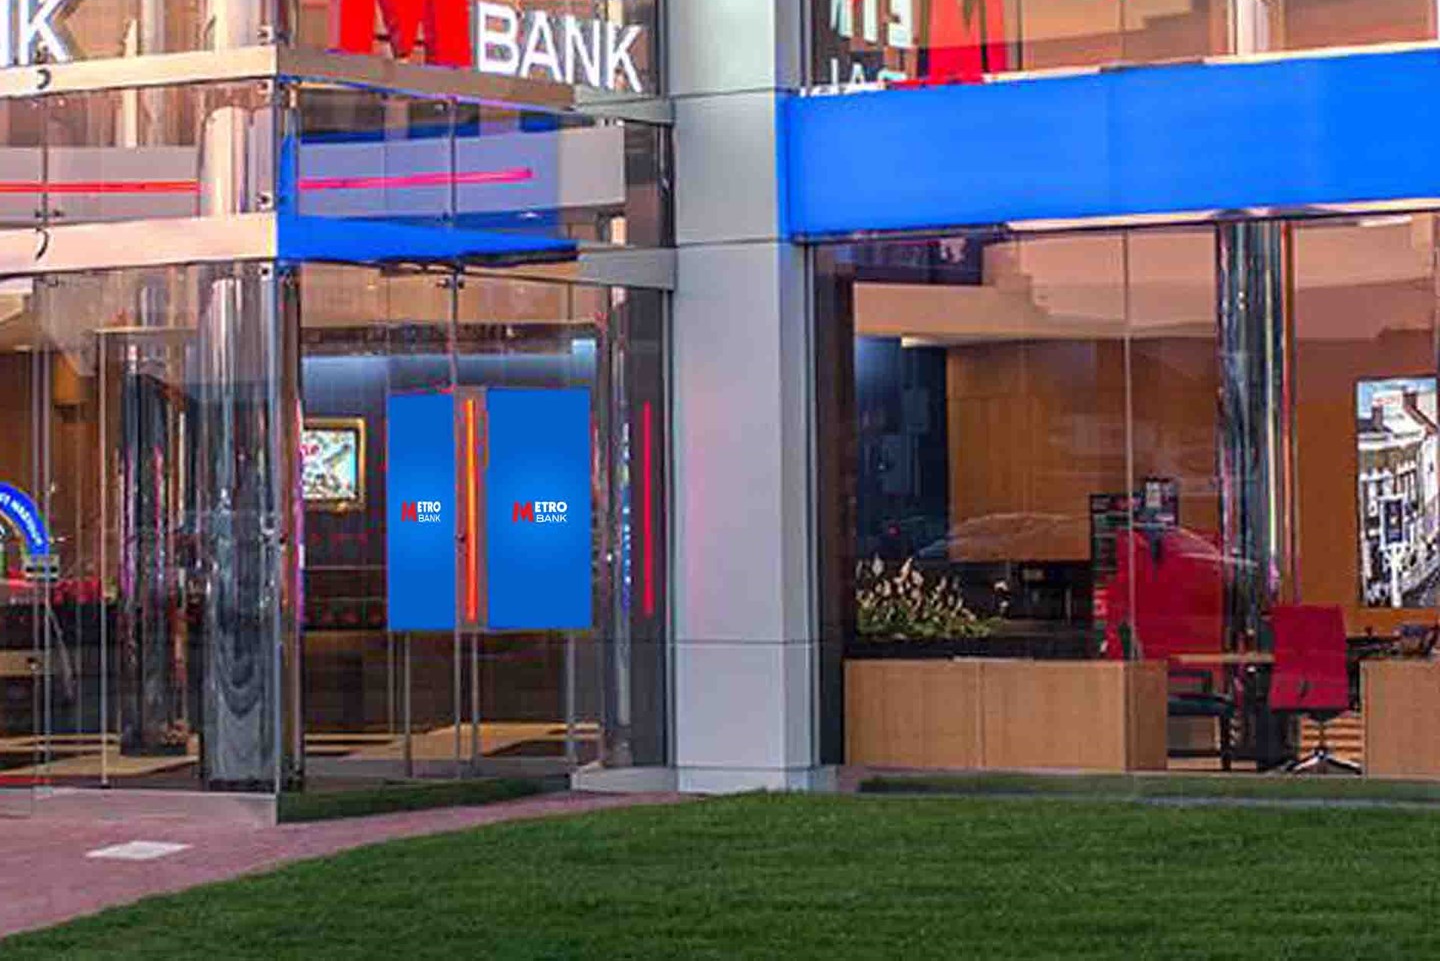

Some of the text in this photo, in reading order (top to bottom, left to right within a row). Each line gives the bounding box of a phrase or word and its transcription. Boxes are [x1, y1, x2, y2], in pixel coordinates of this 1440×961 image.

[474, 2, 643, 93] BANK
[401, 501, 441, 522] METRO
[512, 501, 567, 523] METRO
[536, 515, 567, 523] BANK
